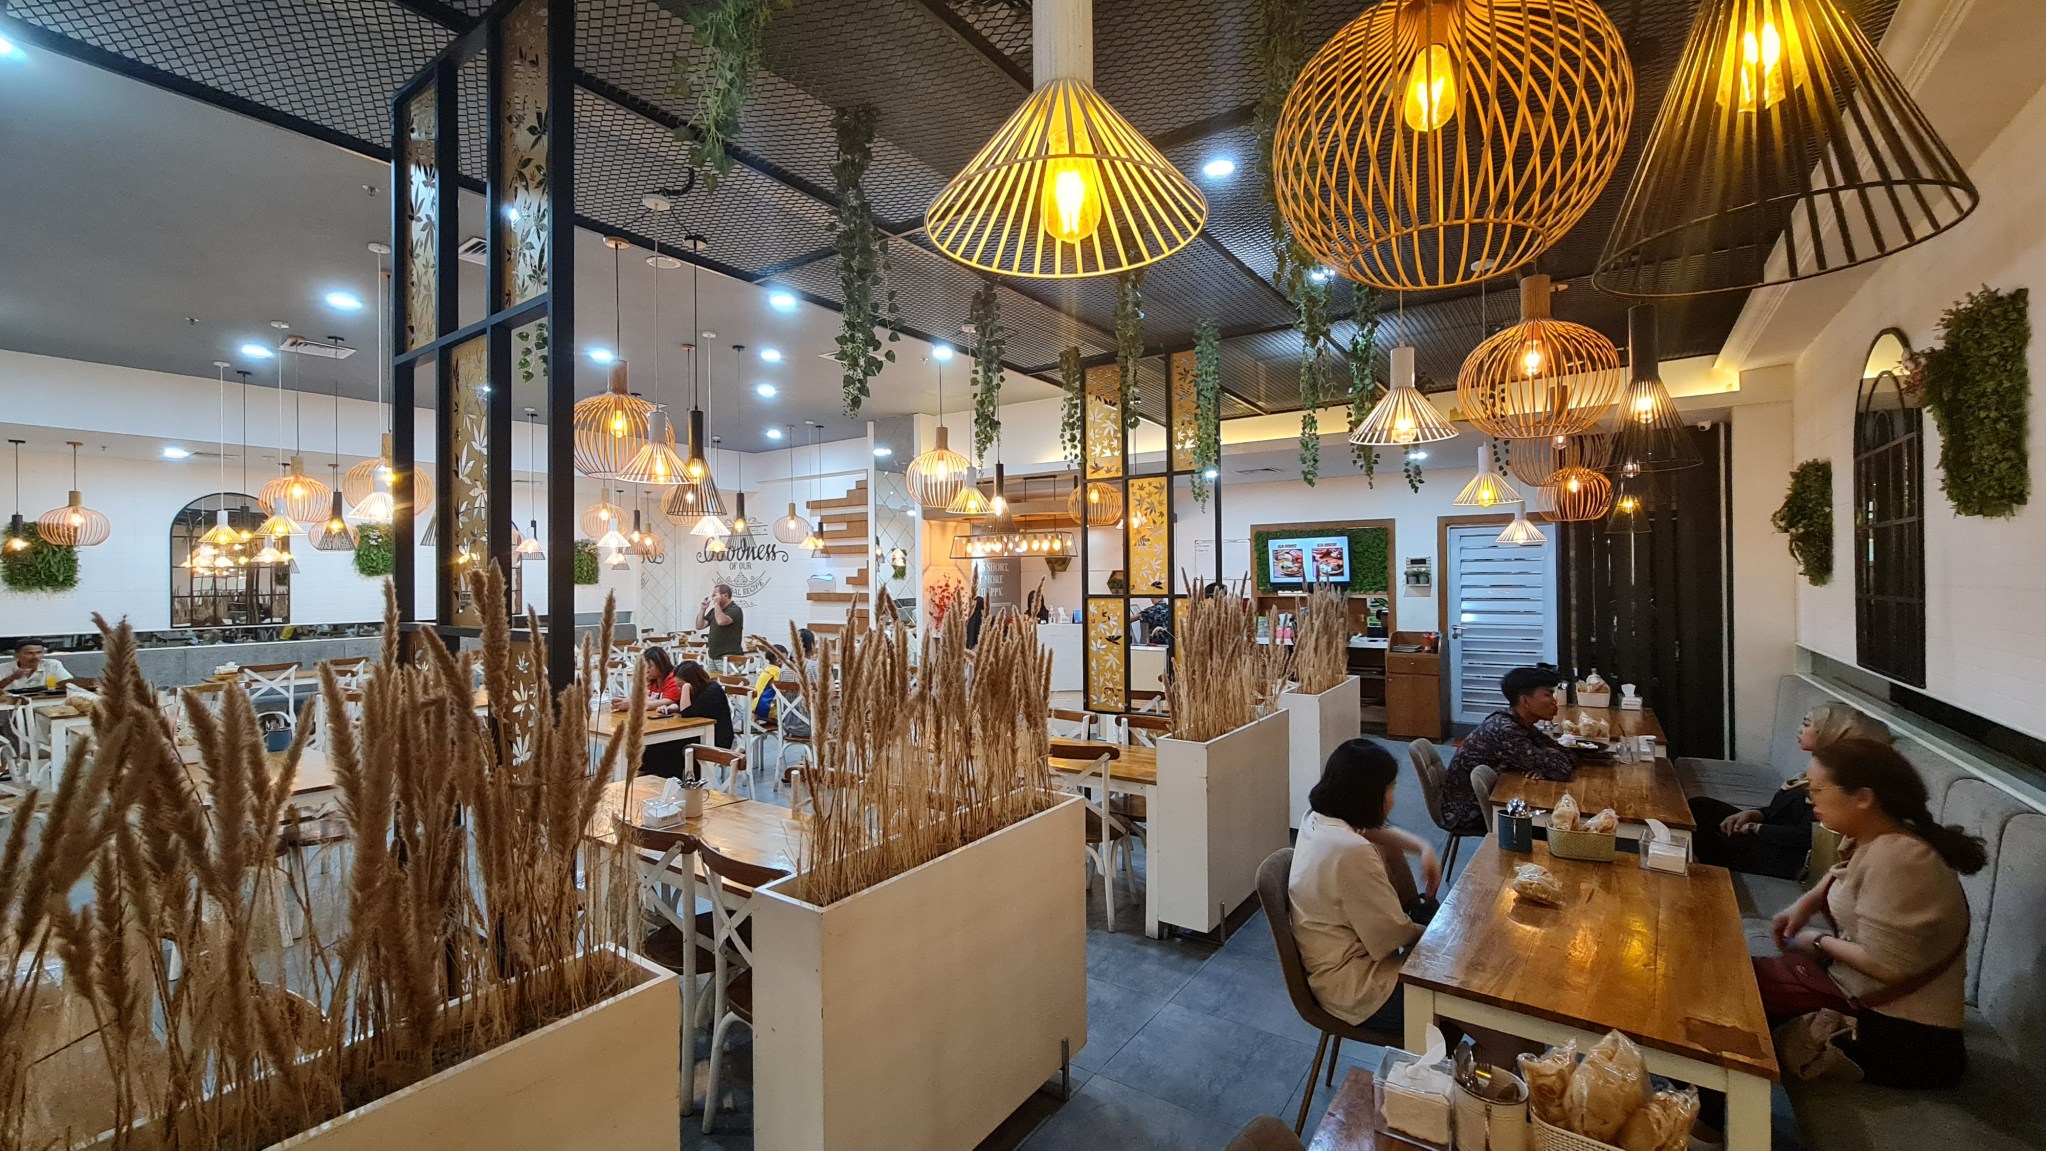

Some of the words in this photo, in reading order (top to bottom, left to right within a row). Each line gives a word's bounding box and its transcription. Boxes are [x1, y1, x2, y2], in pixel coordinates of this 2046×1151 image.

[729, 562, 738, 570] OF
[739, 562, 752, 570] OUR
[742, 578, 765, 596] RECIPE
